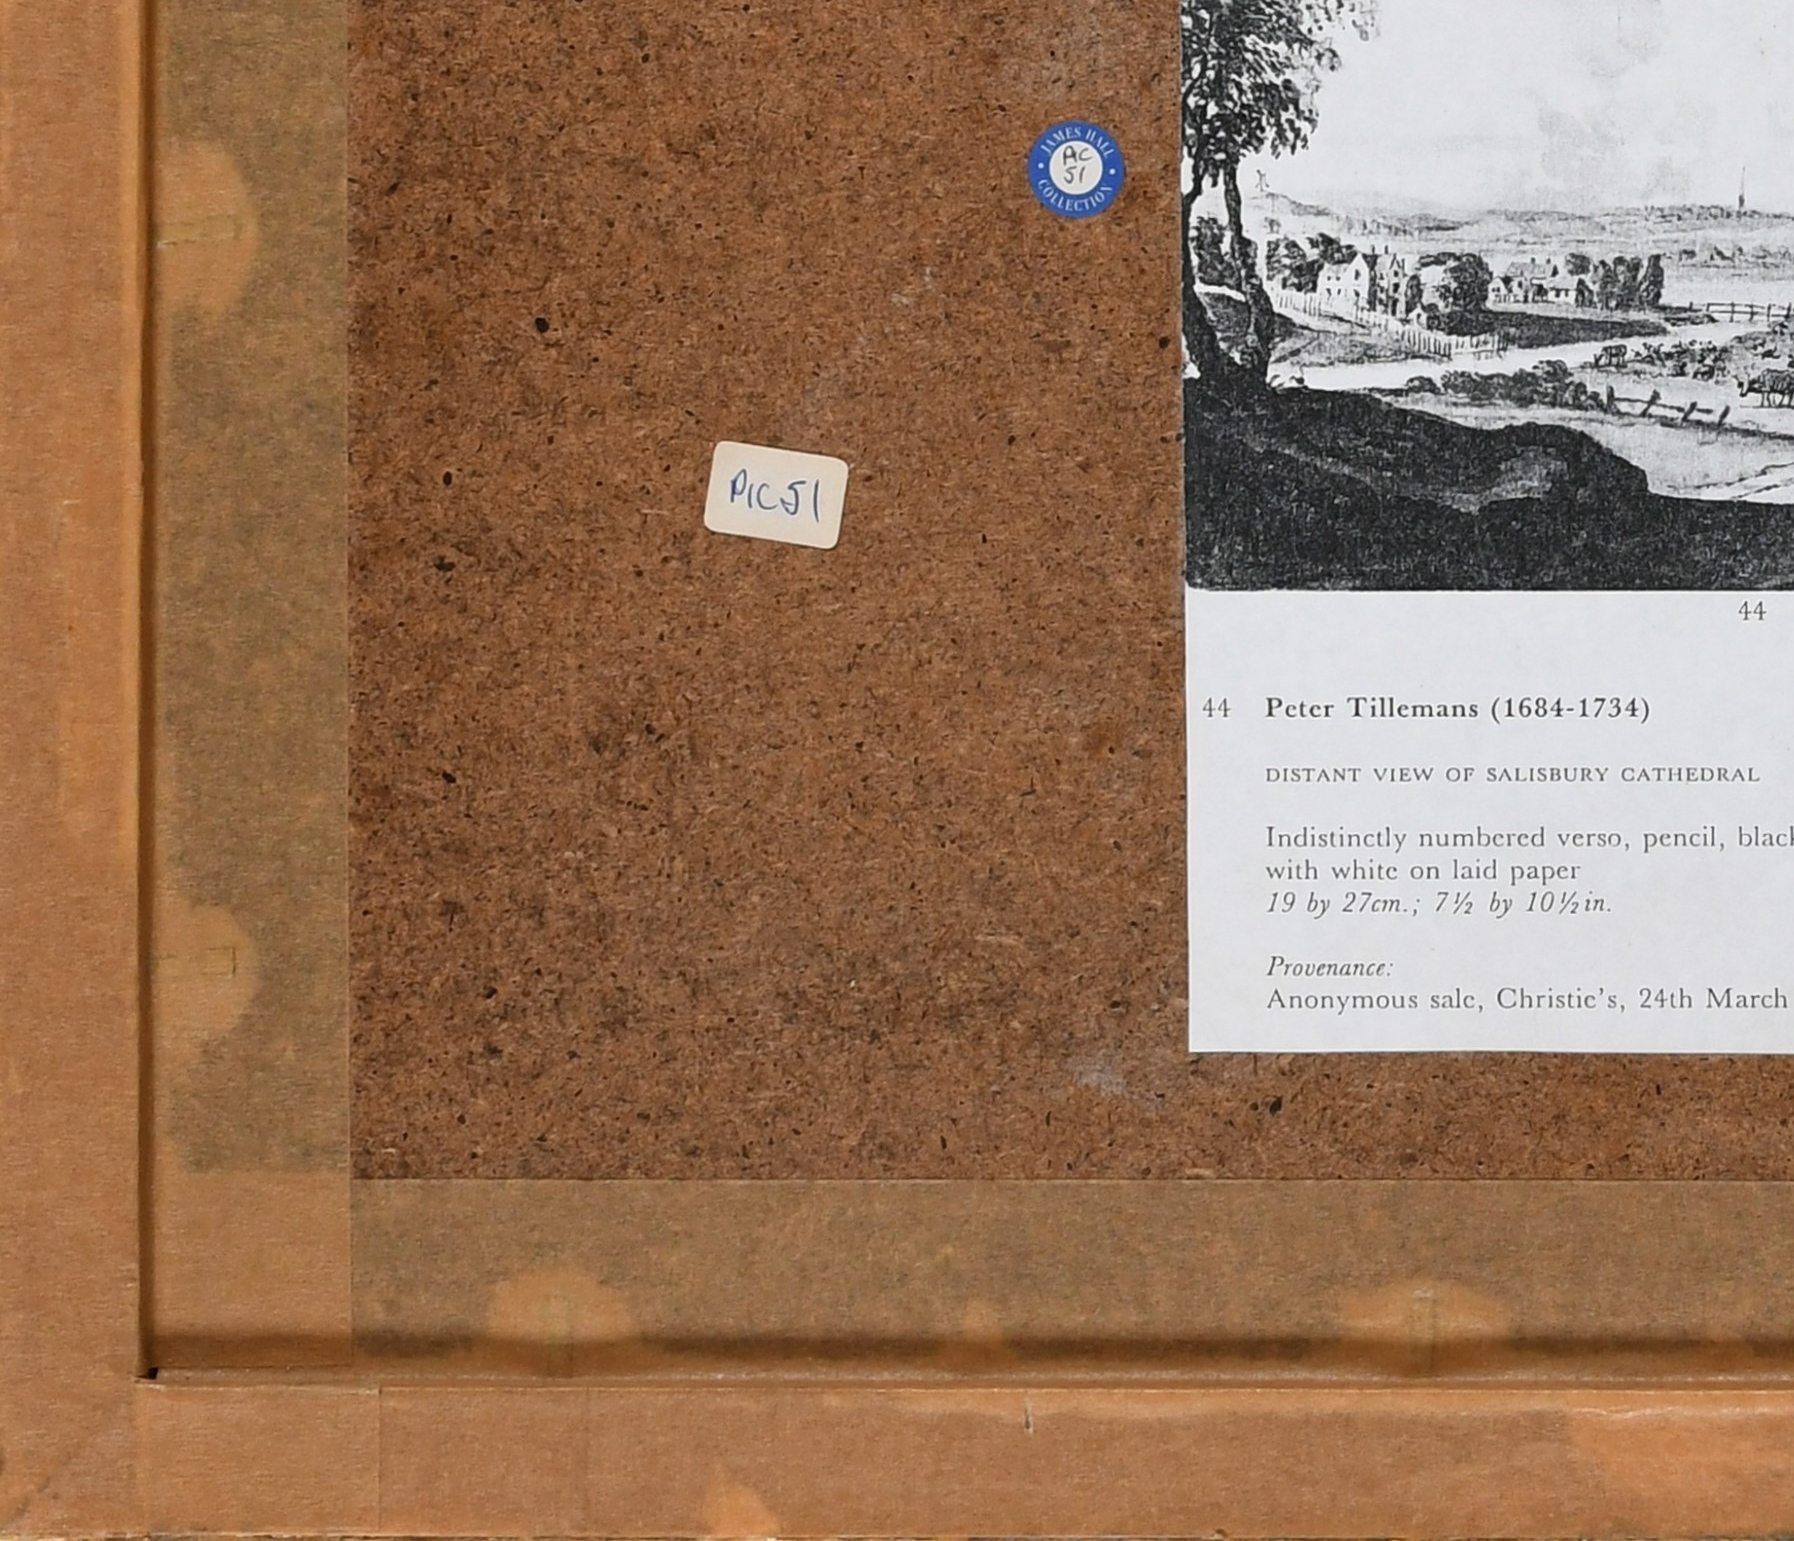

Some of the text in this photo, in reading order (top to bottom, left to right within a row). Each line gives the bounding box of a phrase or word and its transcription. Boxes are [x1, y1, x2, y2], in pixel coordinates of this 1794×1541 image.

[1040, 127, 1115, 159] JAMES HALL
[1063, 166, 1086, 185] 51
[1038, 179, 1113, 212] COLLECTION
[1738, 600, 1767, 621] 44
[1202, 696, 1650, 725] 44 Peter Tillemans (1684-1734)
[1265, 767, 1761, 783] DISTANT VIEW OF SALISBURY CATHEDRAL
[1266, 825, 1407, 854] Indistinctly
[1419, 825, 1545, 848] numbered
[1557, 833, 1630, 852] verso,
[1643, 825, 1725, 854] pencil,
[1265, 858, 1581, 887] with white on laid paper
[1267, 891, 1296, 913] 19
[1306, 891, 1331, 920] by
[1341, 891, 1421, 917] 27cm.;
[1489, 890, 1513, 920] by
[1266, 955, 1394, 977] Provenance:
[1266, 988, 1418, 1015] Anonymous
[1430, 987, 1484, 1013] sale,
[1496, 987, 1625, 1013] Christie's,
[1639, 987, 1693, 1009] 24th
[1706, 987, 1788, 1009] March
